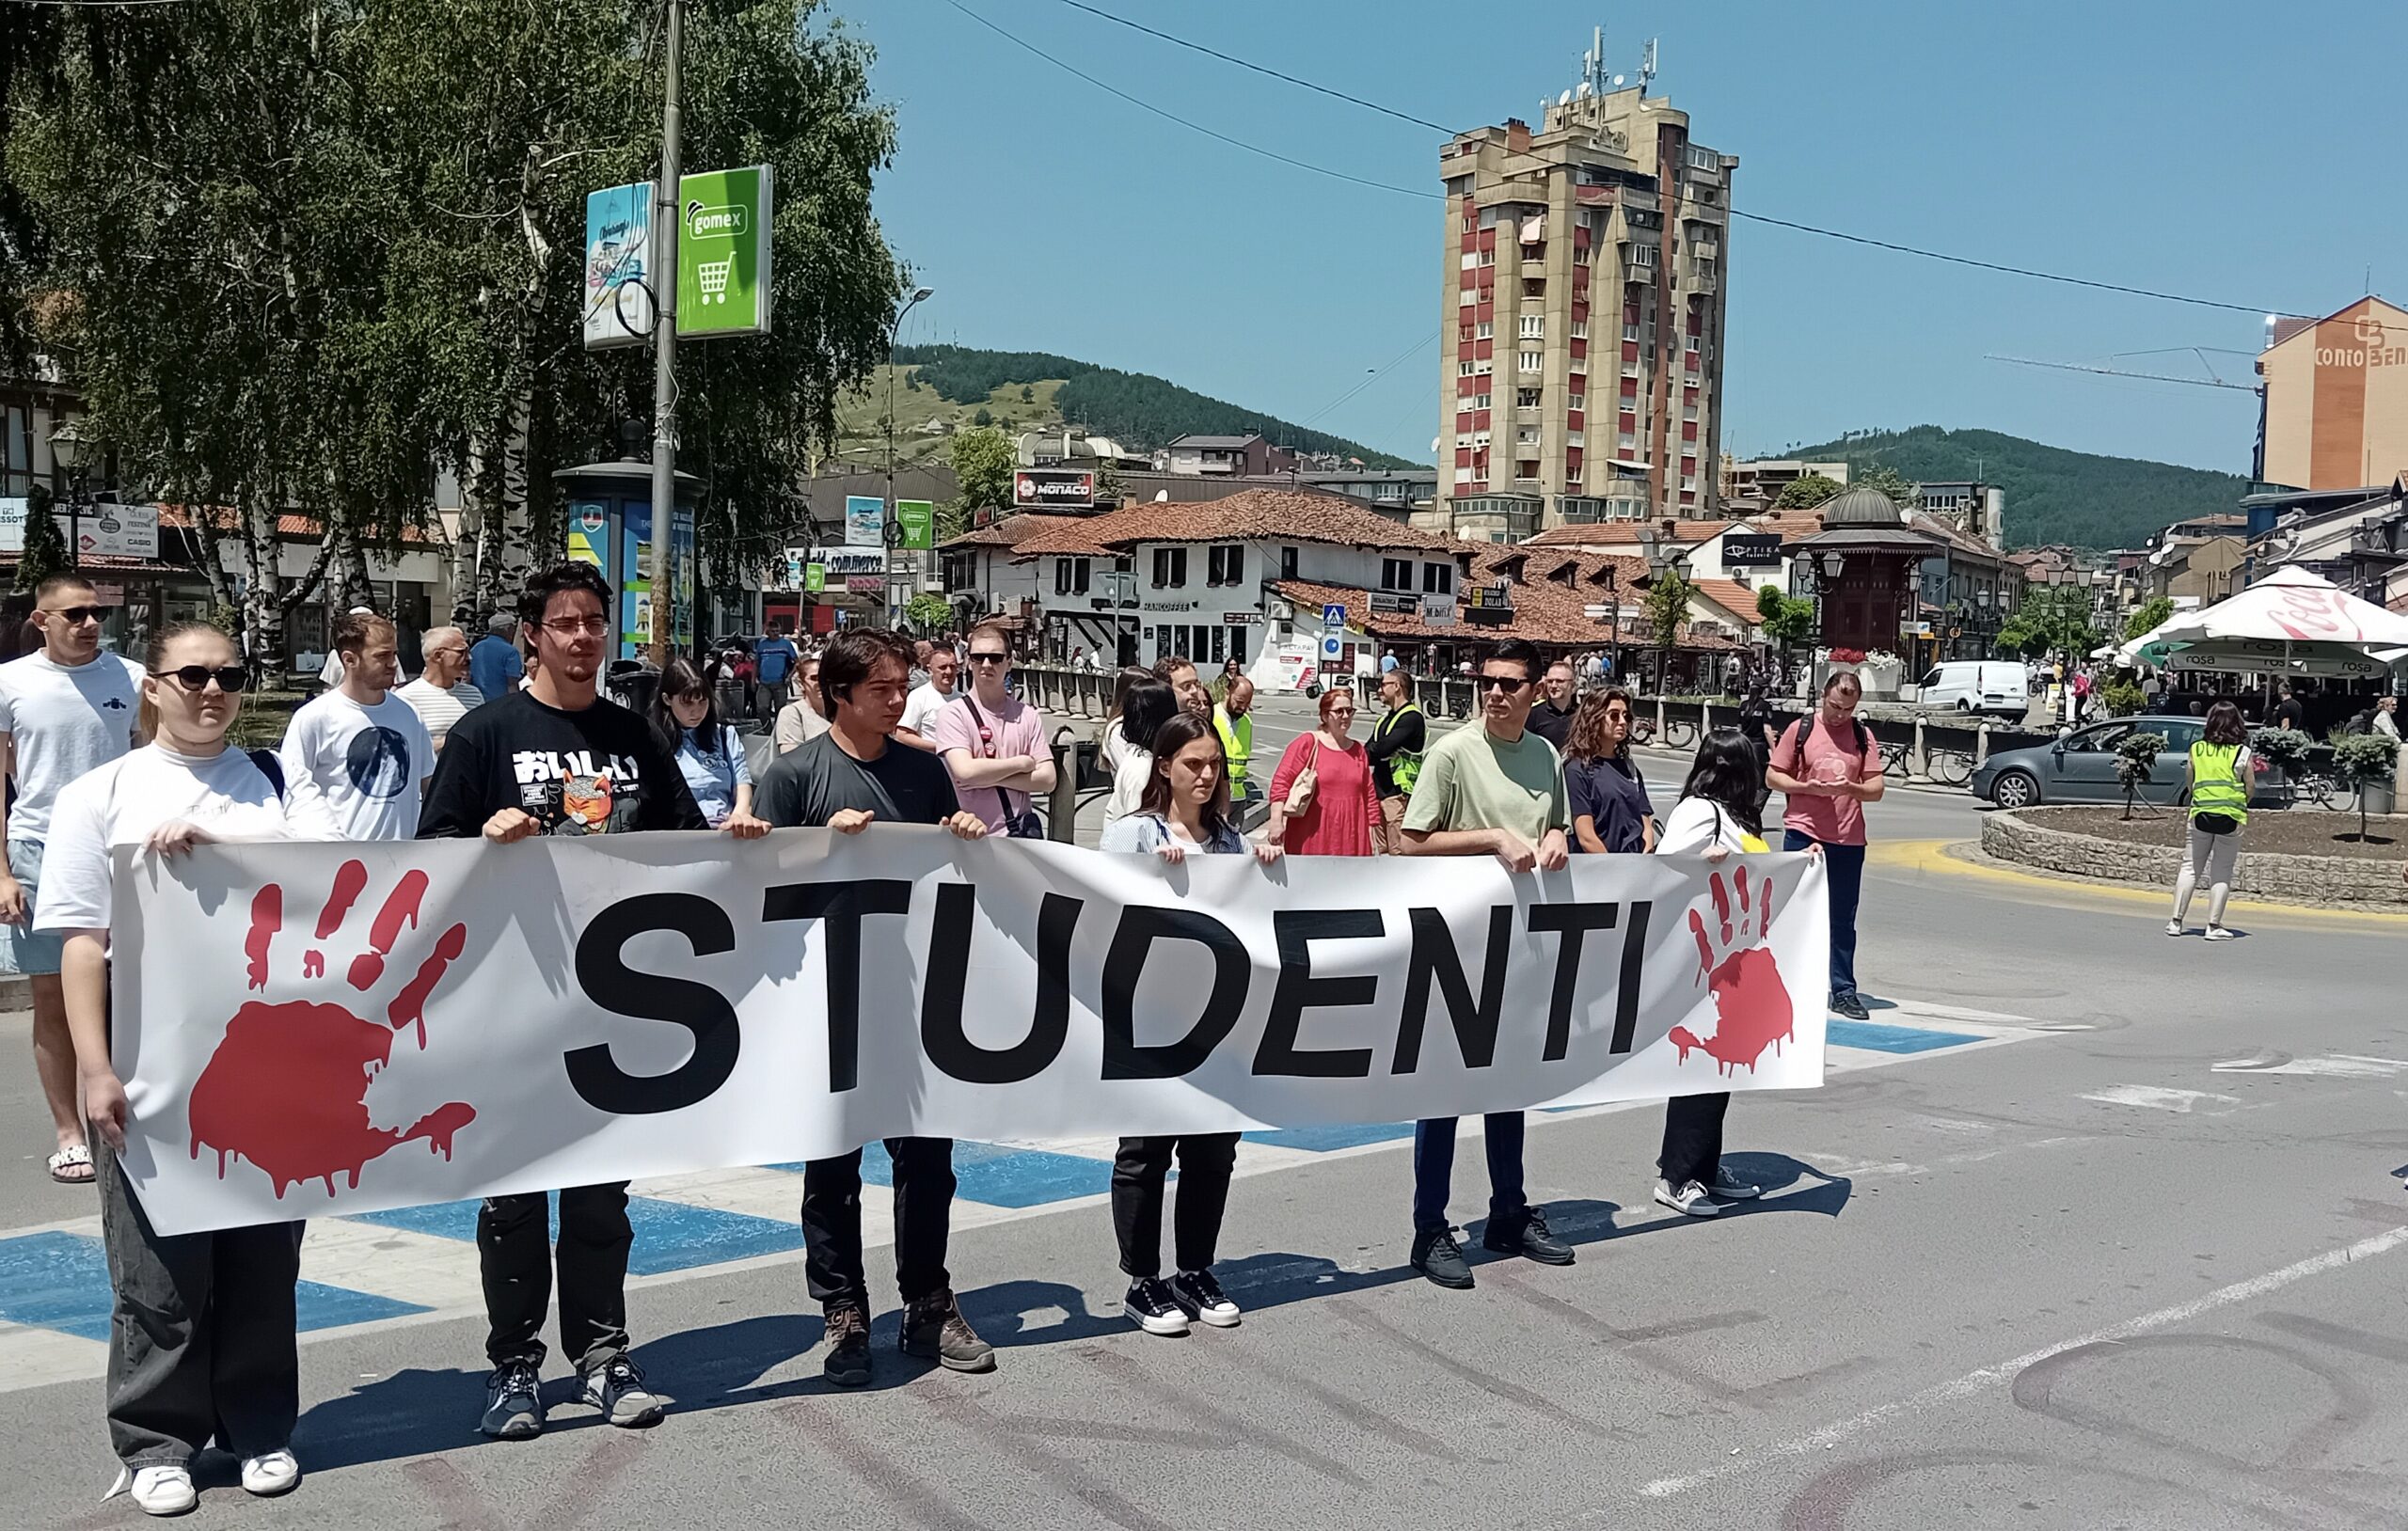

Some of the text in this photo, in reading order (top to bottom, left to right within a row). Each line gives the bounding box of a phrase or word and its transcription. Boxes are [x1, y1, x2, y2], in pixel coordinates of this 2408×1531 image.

[694, 213, 741, 234] gomex
[2370, 347, 2408, 367] BEN
[1037, 484, 1090, 496] MONACO
[127, 538, 151, 546] CASIO
[2185, 655, 2215, 665] rosa
[2341, 662, 2372, 672] rosa
[564, 878, 1653, 1115] STUDENTI
